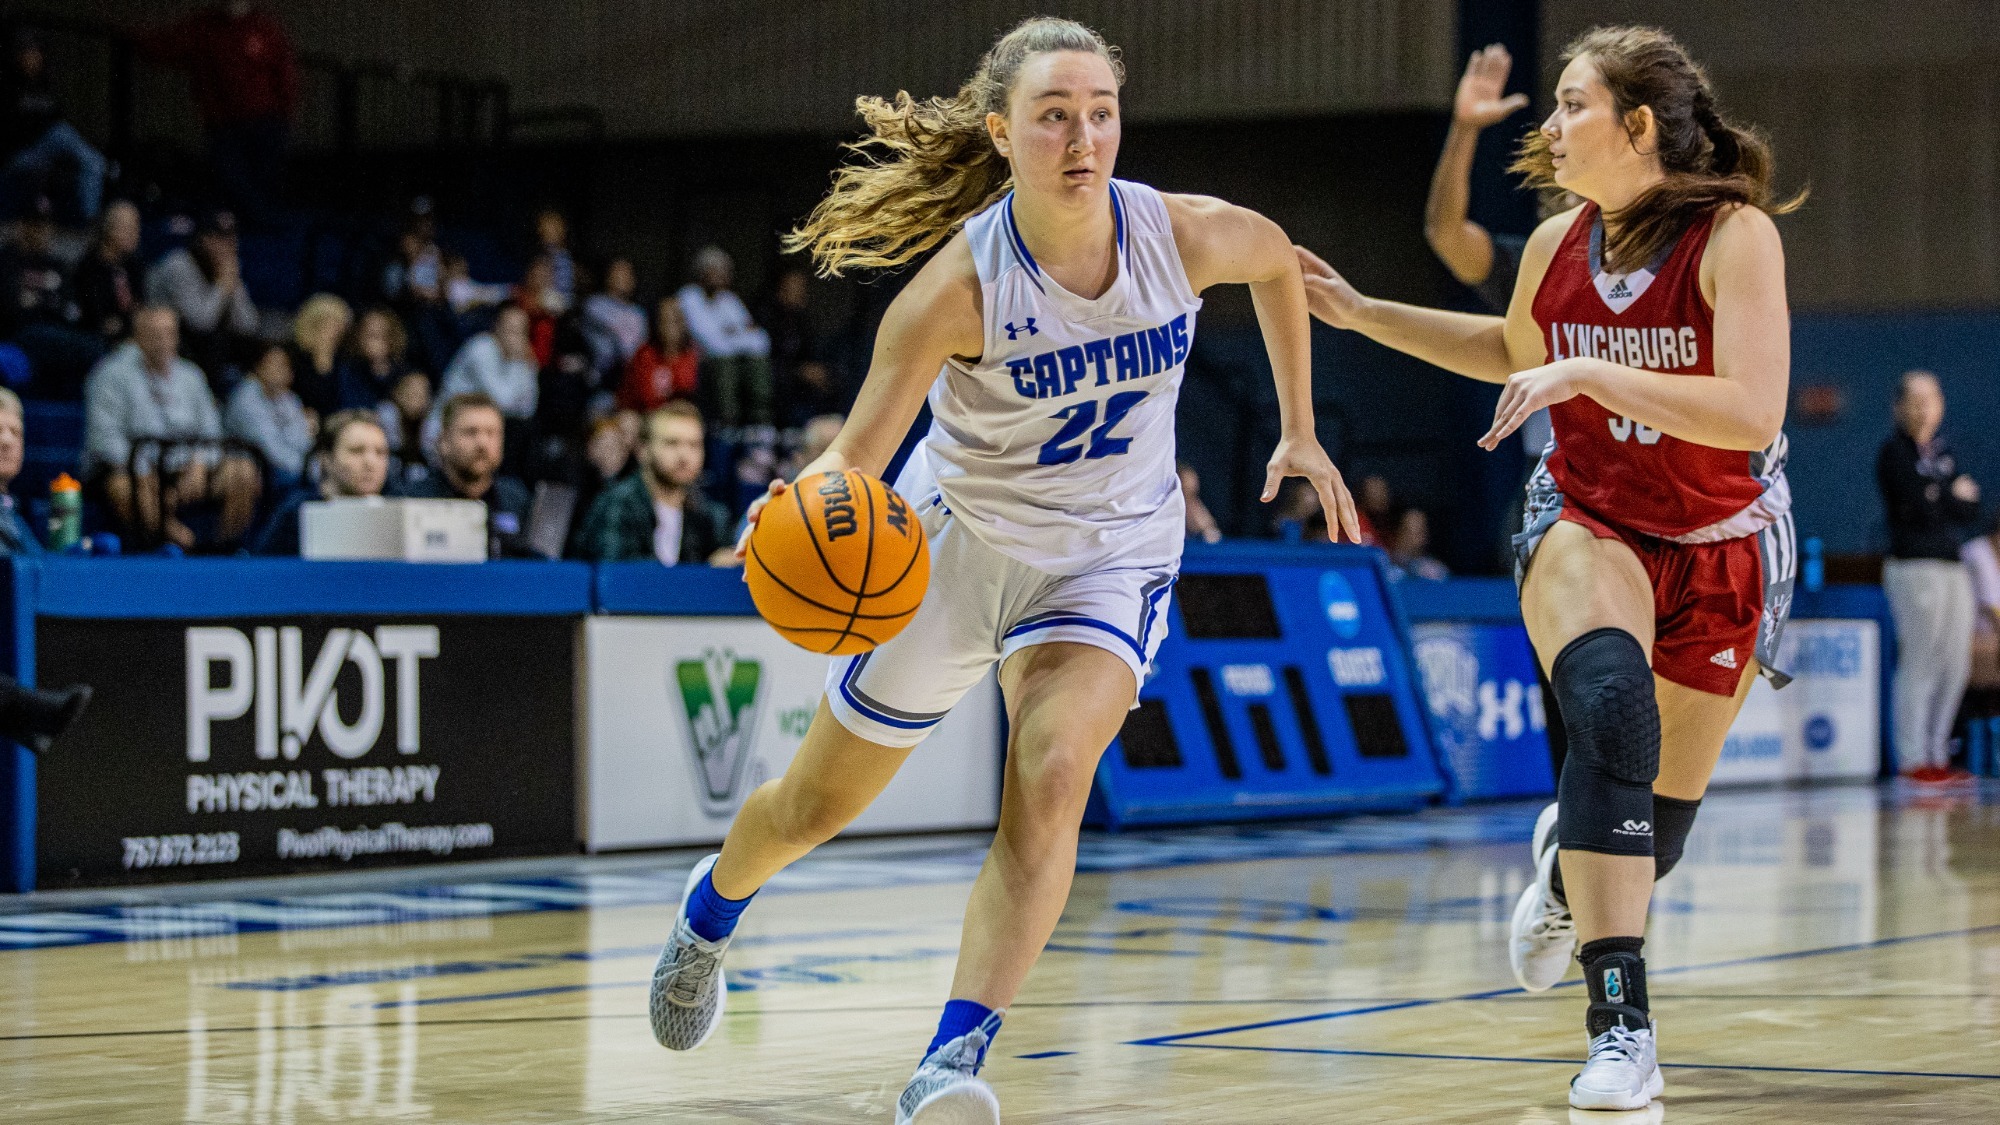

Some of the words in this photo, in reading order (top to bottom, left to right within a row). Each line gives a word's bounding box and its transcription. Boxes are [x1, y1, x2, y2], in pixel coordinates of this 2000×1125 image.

[1607, 291, 1633, 299] adidas
[1006, 313, 1189, 399] CAPTAINS
[1551, 322, 1698, 369] LYNCHBURG
[1037, 391, 1150, 465] 22
[186, 625, 440, 762] PIVOT
[187, 770, 319, 813] PHYSICAL
[322, 765, 440, 807] THERAPY
